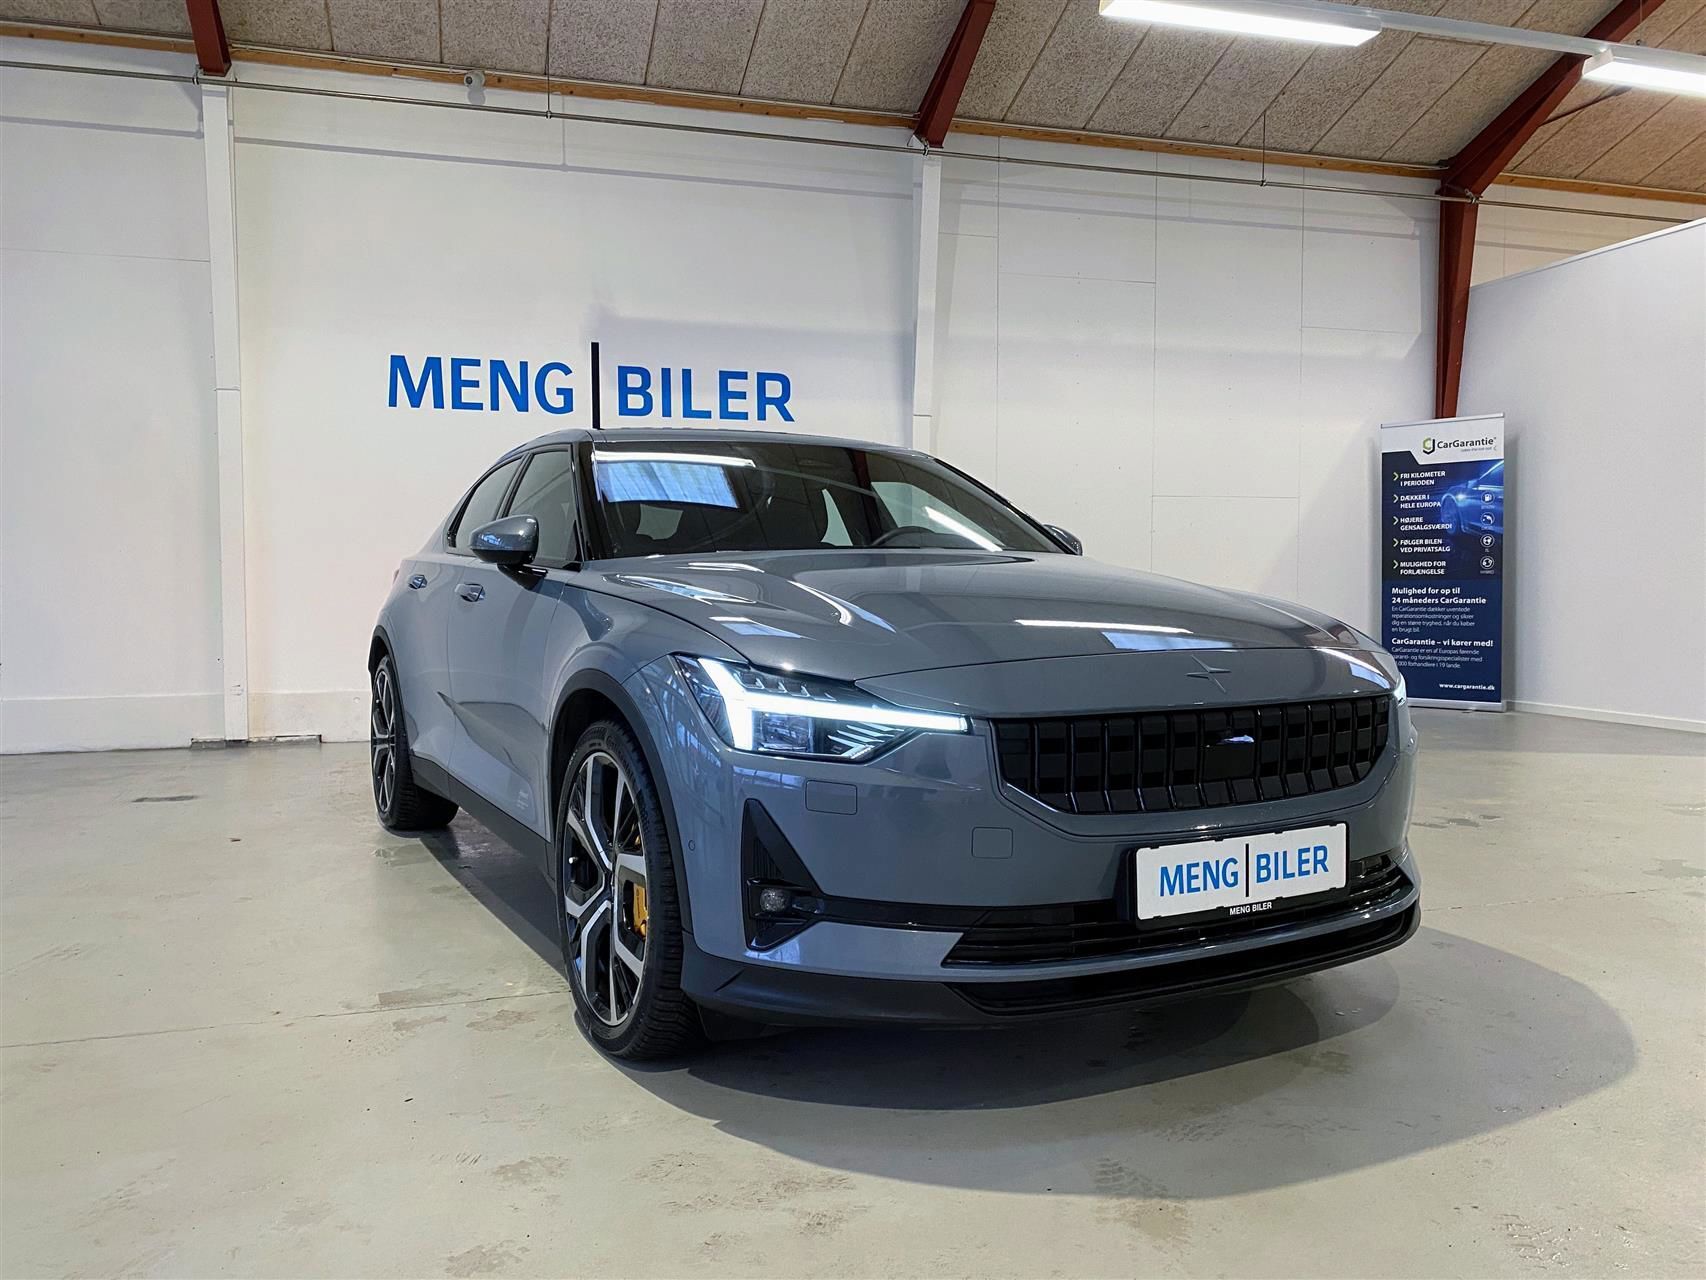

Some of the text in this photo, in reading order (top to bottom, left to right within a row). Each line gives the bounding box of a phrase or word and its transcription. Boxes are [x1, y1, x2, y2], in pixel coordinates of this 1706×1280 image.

[388, 354, 795, 422] MENG BILER
[1400, 523, 1452, 531] GENSALGSVÆRDI
[1391, 587, 1426, 595] Mulighed
[1439, 683, 1495, 691] www.cargarantie.dk
[1159, 844, 1329, 897] MENG BILER
[1229, 901, 1273, 916] MENG BILER
